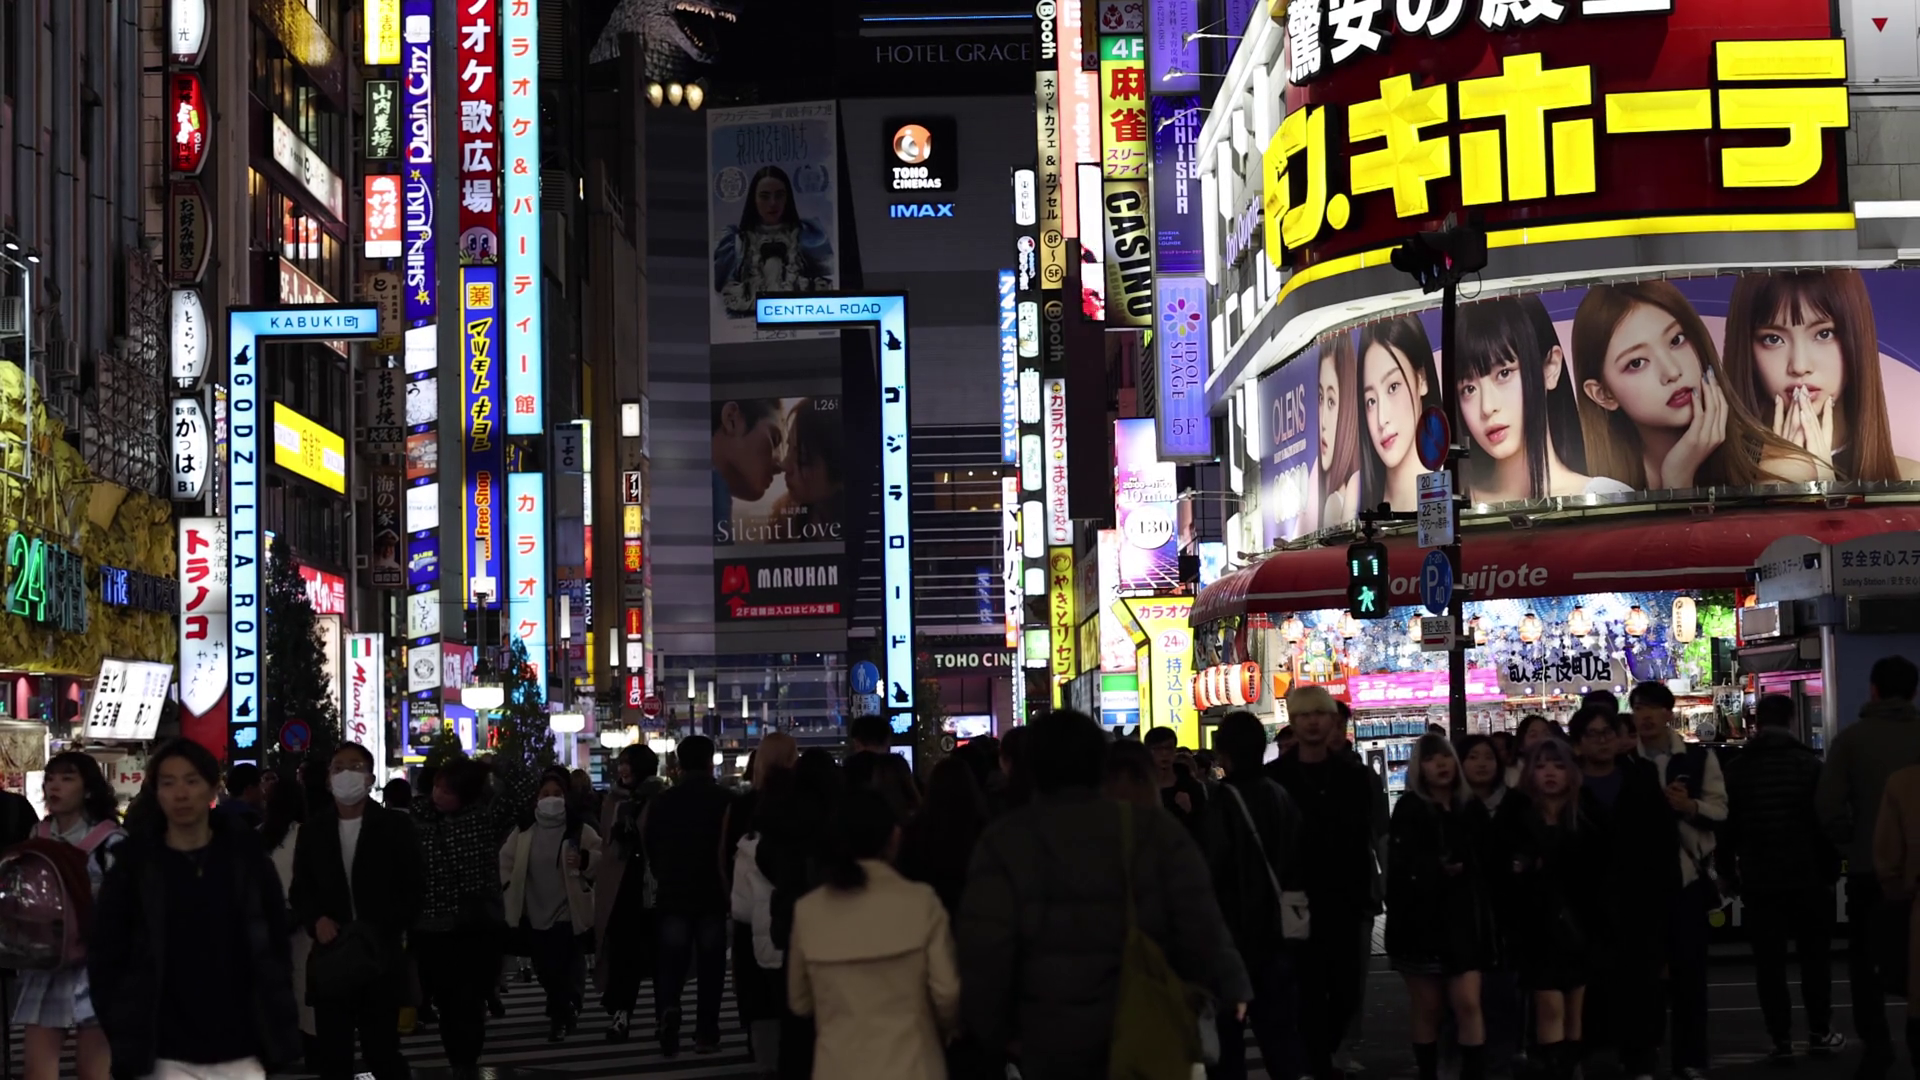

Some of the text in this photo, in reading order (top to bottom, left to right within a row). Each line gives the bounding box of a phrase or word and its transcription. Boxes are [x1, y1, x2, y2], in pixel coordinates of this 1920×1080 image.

[178, 27, 190, 42] 光
[1289, 0, 1671, 82] 驚安の
[876, 45, 949, 63] HOTEL
[371, 83, 393, 147] 山内農場
[1043, 79, 1057, 148] ネットカフェ
[1110, 66, 1147, 142] 麻雀
[893, 167, 929, 179] TOHO
[893, 178, 942, 189] CINEMAS
[890, 203, 954, 218] IMAX
[407, 183, 429, 287] SHINJUKU
[470, 286, 490, 301] 薬
[764, 303, 882, 316] CENTRAL ROAD
[1000, 275, 1017, 330] 747
[1044, 300, 1065, 362] Booth
[177, 376, 194, 388] 1F
[1170, 341, 1185, 399] STAGE
[1185, 341, 1198, 389] IDOL
[467, 318, 492, 452] マツモトキヨシ
[175, 407, 196, 416] 新宿
[1051, 394, 1065, 449] カラオケ
[1172, 418, 1198, 436] 5F
[1272, 384, 1306, 446] OLENS
[177, 481, 195, 492] B1
[377, 475, 395, 526] 海の家
[475, 471, 491, 507] Shop
[234, 373, 255, 686] GODZILLA ROAD
[475, 513, 491, 537] Free
[716, 517, 842, 543] Silent Love
[883, 385, 908, 650] ゴジラロード
[185, 529, 209, 640] トラノコ
[757, 565, 838, 589] MARUHAN
[1462, 565, 1549, 598] uijote
[1138, 605, 1191, 620] カラオケ
[934, 654, 979, 668] TOHO
[352, 661, 367, 718] Miami
